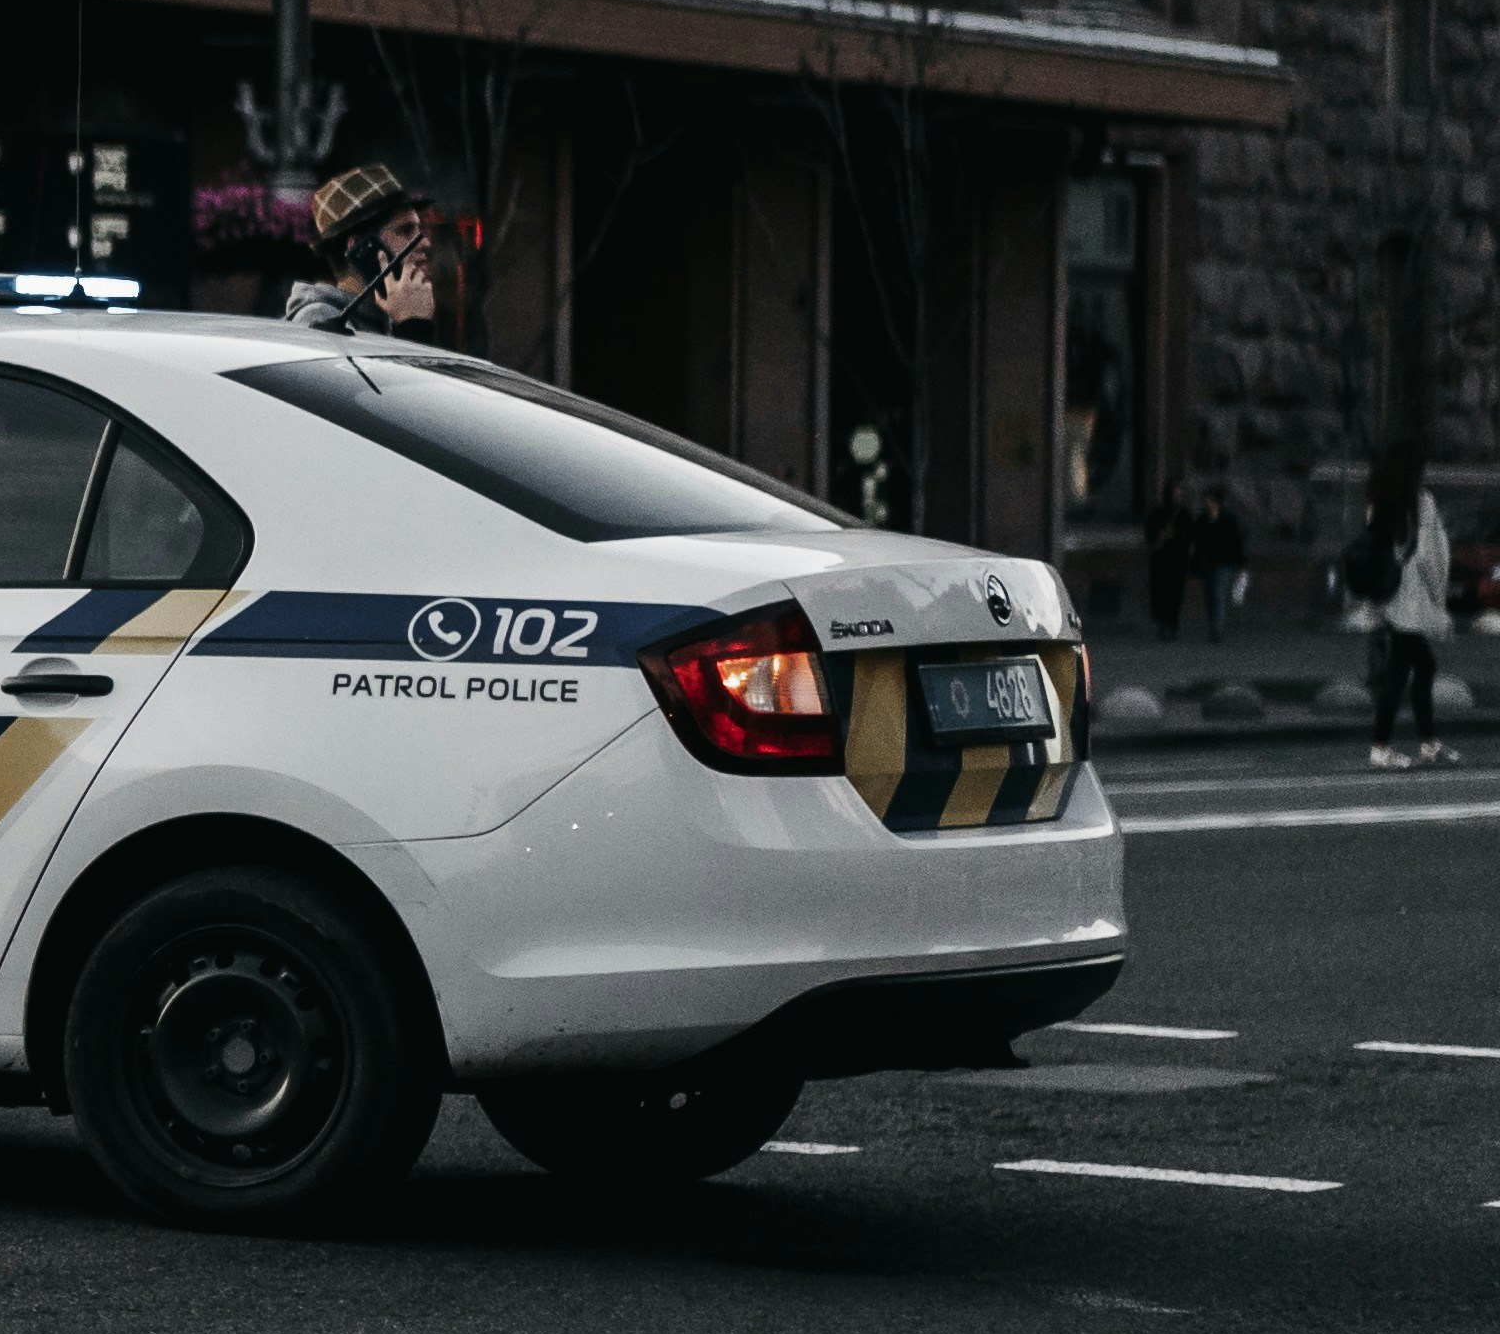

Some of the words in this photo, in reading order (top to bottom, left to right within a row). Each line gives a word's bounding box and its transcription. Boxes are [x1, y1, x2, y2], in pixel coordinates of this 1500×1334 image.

[493, 608, 598, 658] 102
[332, 674, 456, 700] PATROL
[467, 678, 579, 703] POLICE
